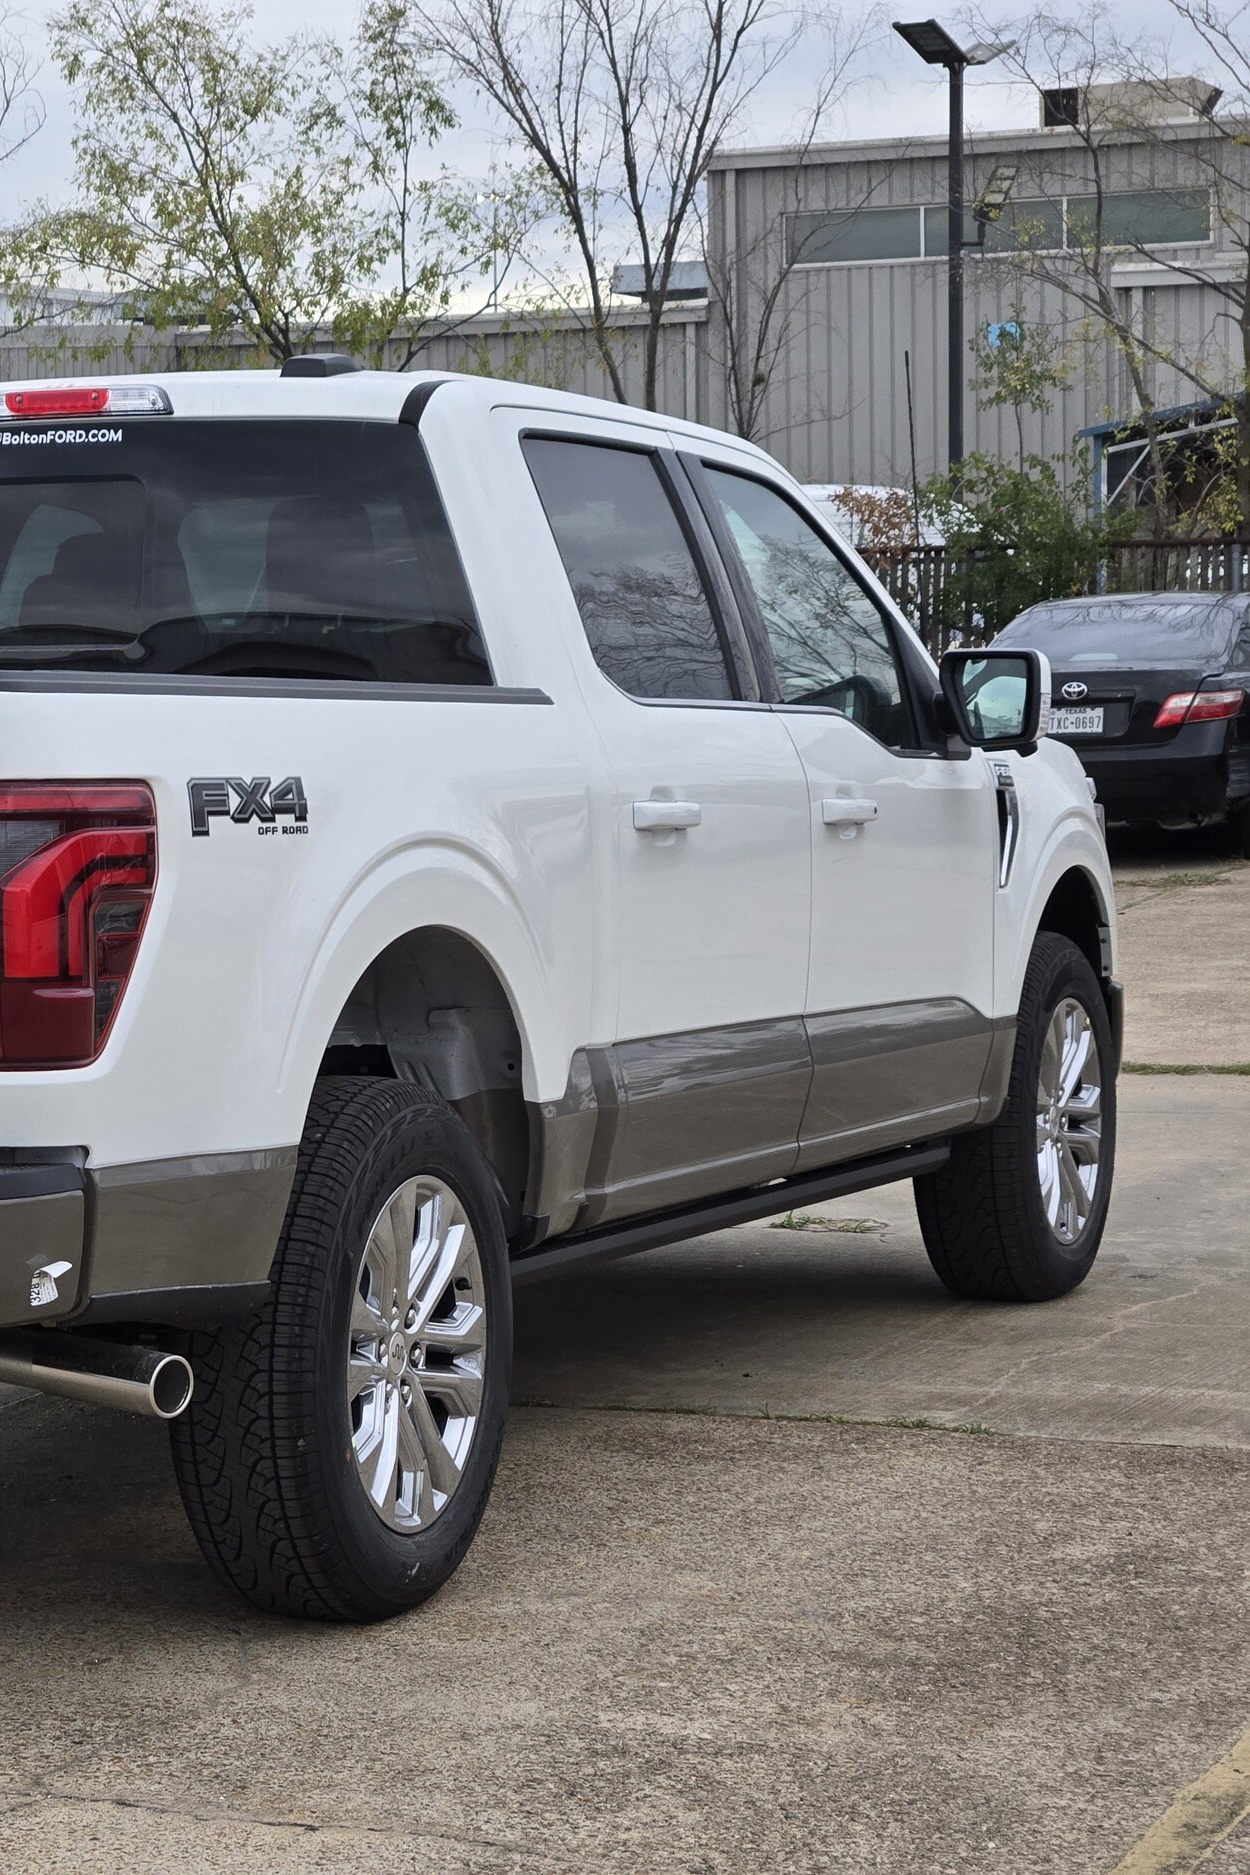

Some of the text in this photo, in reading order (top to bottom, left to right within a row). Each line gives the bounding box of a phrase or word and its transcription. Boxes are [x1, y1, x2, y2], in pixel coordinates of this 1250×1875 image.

[1065, 707, 1087, 715] TEXAS
[187, 776, 308, 837] FX4
[258, 825, 309, 835] OFF ROAD
